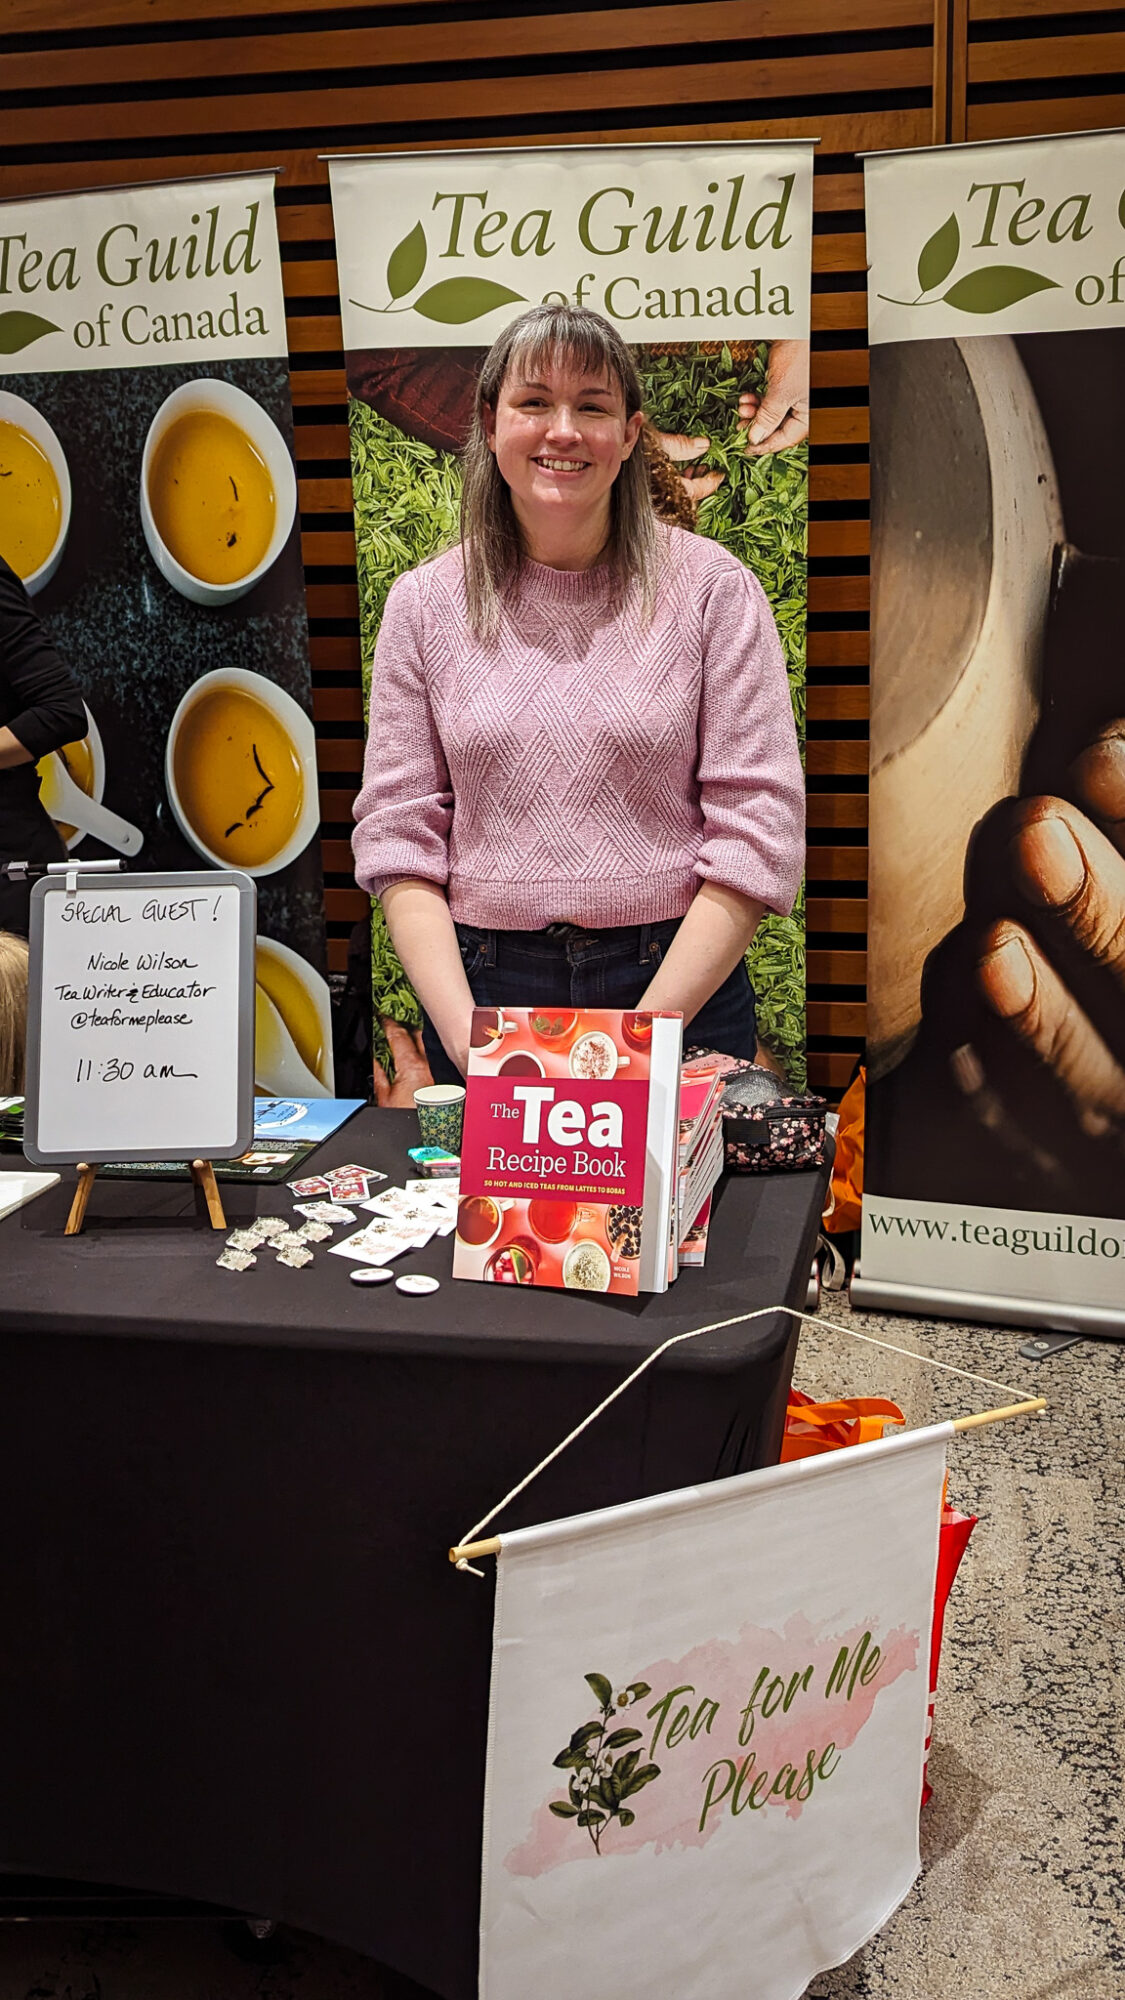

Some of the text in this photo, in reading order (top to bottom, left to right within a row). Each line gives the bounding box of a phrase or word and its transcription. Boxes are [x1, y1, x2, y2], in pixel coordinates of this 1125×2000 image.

[432, 173, 797, 258] Tea Guild
[966, 178, 1094, 249] Tea
[0, 201, 262, 294] Tea Guild
[604, 268, 795, 320] Canada
[1075, 256, 1125, 306] of
[73, 292, 269, 348] of Canada
[61, 900, 132, 924] SPECIAL
[87, 951, 199, 971] Nicole Wilson
[54, 984, 82, 1001] Tea
[83, 983, 127, 1001] Writer
[141, 980, 217, 999] Educator
[70, 1007, 193, 1033] @teaformeplease
[77, 1058, 198, 1083] 11:30 am
[490, 1085, 624, 1149] The Tea
[486, 1146, 627, 1178] Recipe Book
[493, 1180, 508, 1188] HOT
[508, 1181, 523, 1189] AND
[523, 1182, 539, 1190] ICED
[540, 1183, 556, 1191] TEAS
[556, 1184, 575, 1192] FROM
[575, 1185, 597, 1194] LATTES
[598, 1186, 606, 1194] TO
[606, 1187, 626, 1195] BOBAS
[868, 1213, 1125, 1259] www.teaguildo
[646, 1631, 888, 1761] Tea for Me
[698, 1742, 842, 1833] Please
